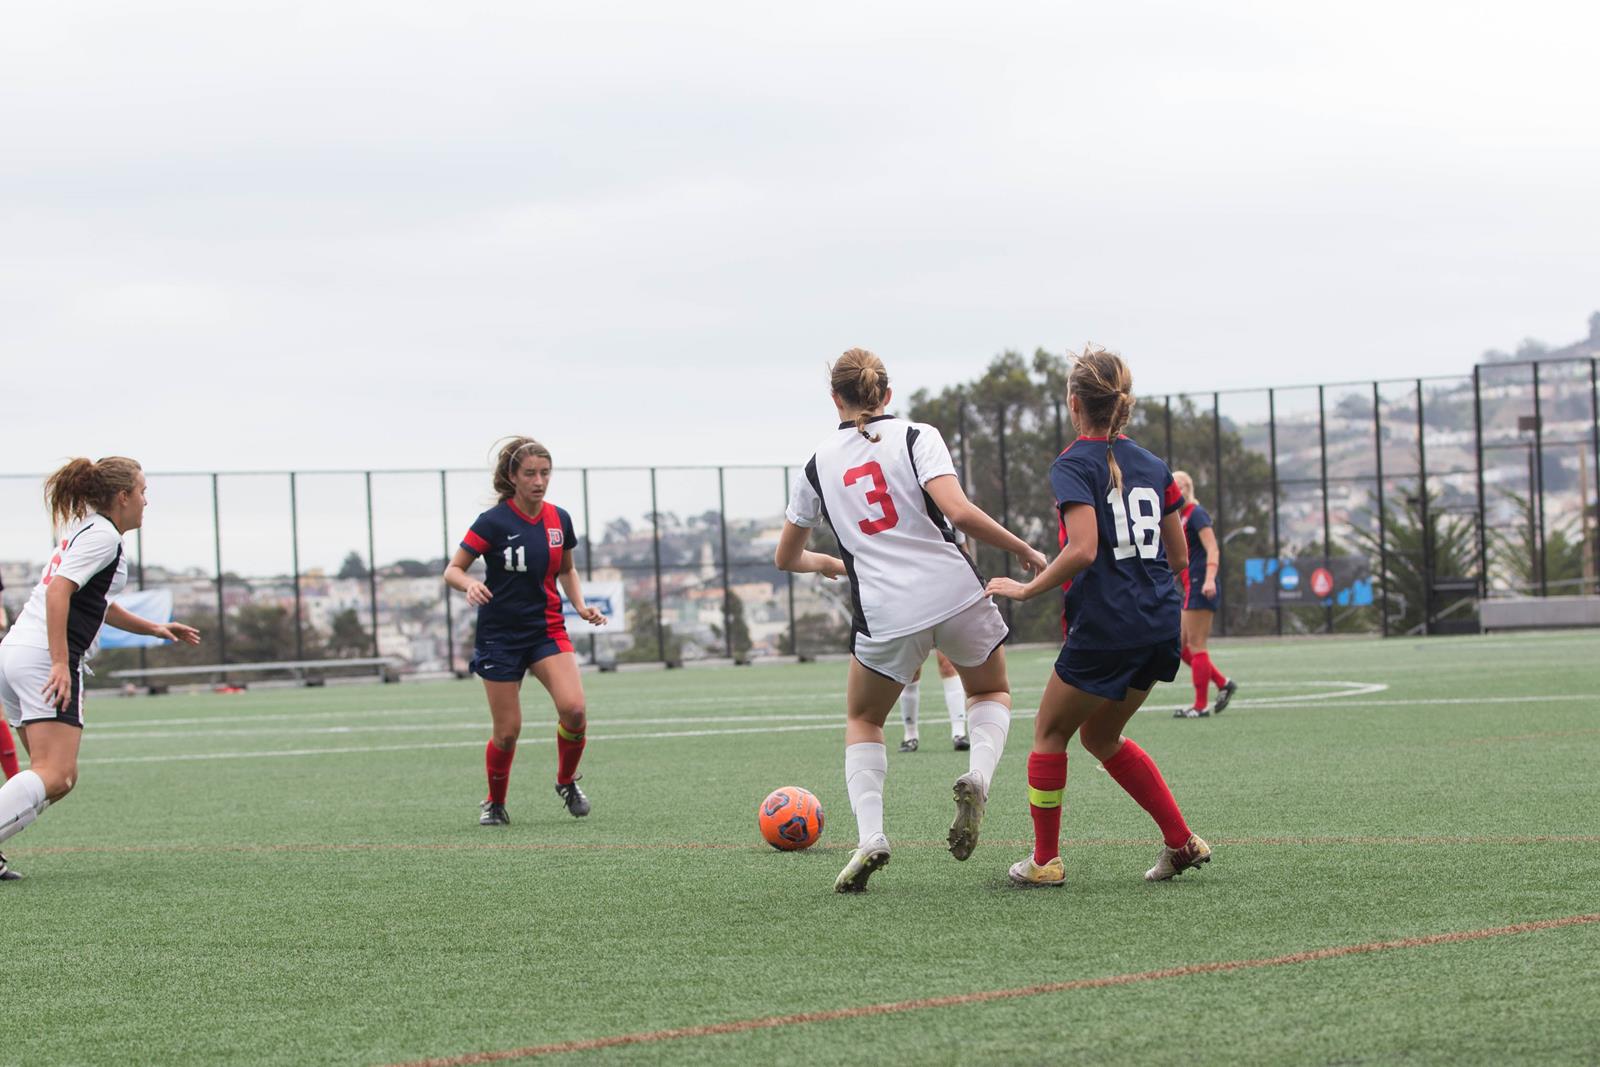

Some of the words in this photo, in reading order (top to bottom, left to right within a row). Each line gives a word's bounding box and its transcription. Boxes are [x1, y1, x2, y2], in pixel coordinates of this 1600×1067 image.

[843, 460, 899, 536] 3
[1107, 487, 1161, 560] 18
[503, 545, 528, 572] 11
